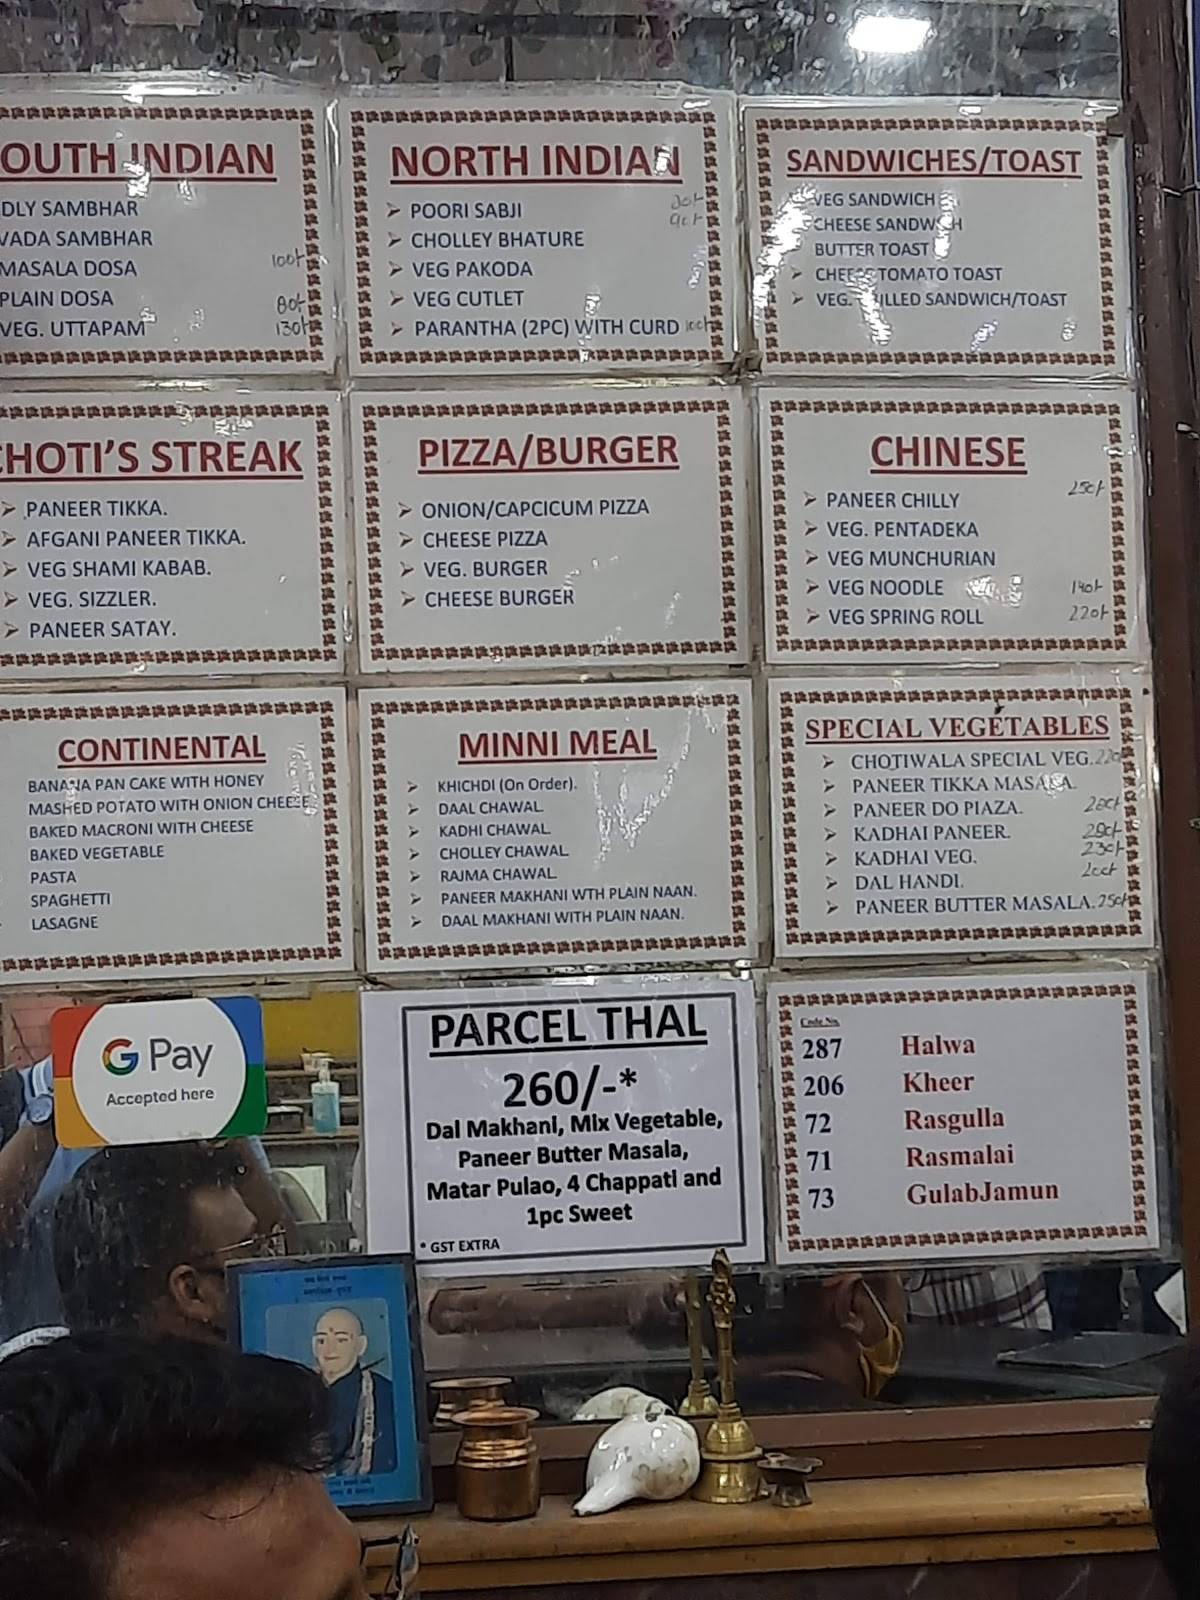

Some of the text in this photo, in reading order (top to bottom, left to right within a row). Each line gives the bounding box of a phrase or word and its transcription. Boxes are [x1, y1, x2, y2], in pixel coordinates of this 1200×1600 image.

[131, 143, 274, 174] INDIAN
[391, 146, 680, 177] NORTH INDIAN
[787, 147, 1081, 175] SANDWICHES/TOAST
[815, 192, 935, 207] VEG SANDWICH
[43, 201, 138, 217] SAMBHAR
[411, 202, 522, 219] POORI SABJI
[813, 218, 871, 232] CHEESE
[56, 231, 153, 247] SAMBHAR
[412, 231, 584, 249] CHOLLEY BHATURE
[815, 242, 928, 257] BUTTER TOAST
[0, 261, 137, 277] MASALA DOSA
[413, 261, 533, 278] VEG PAKODA
[879, 267, 1002, 281] TOMATO TOAST
[0, 291, 114, 307] PLAIN DOSA
[414, 291, 524, 307] VEG CUTLET
[926, 292, 1067, 308] SANDWICH/TOAST
[0, 321, 145, 338] VEG. UTTAPAM
[415, 319, 679, 339] PARANTHA (2PC) WITH CURD
[152, 440, 303, 473] STREAK
[419, 434, 679, 471] PIZZA/BURGER
[871, 436, 1026, 468] CHINESE
[26, 500, 168, 517] PANEER TIKKA.
[827, 492, 960, 508] PANEER CHILLY
[422, 499, 649, 520] ONION/CAPCICUM PIZZA
[828, 521, 979, 537] VEG. PENTADEKA
[27, 530, 246, 548] AFGANI PANEER TIKKA.
[424, 531, 547, 548] CHEESE PIZZA
[828, 551, 996, 566] VEG MUNCHURIAN
[28, 560, 211, 577] VEG SHAMI KABAB.
[424, 561, 547, 577] VEG. BURGER
[829, 580, 944, 595] VEG NOODLE
[29, 591, 156, 608] VEG. SIZZLER.
[425, 589, 574, 608] CHEESE BURGER
[829, 609, 984, 624] VEG SPRING ROLL
[30, 621, 177, 638] PANEER SATAY.
[807, 715, 1109, 739] SPECIAL VEGETABLES
[58, 735, 266, 763] CONTINENTAL
[459, 728, 657, 758] MINNI MEAL
[852, 752, 1046, 770] CHOTIWALA SPECIAL
[95, 774, 264, 791] PAN CAKE WITH HONEY
[438, 780, 495, 792] KHICHDI
[499, 778, 524, 793] (On
[853, 776, 989, 794] PANEER TIKKA
[28, 798, 253, 816] MASHED POTATO WITH ONION
[439, 803, 475, 815] DAAL
[854, 803, 926, 817] PANEER
[932, 802, 959, 816] DO
[29, 820, 254, 839] BAKED MACRONI WITH CHEESE
[440, 824, 483, 838] KADHI
[854, 826, 928, 841] KADHAI
[31, 845, 165, 861] BAKED VEGETABLE
[440, 847, 501, 861] CHOLLEY
[855, 851, 929, 865] KADHAI
[31, 871, 76, 885] PASTA
[856, 875, 894, 890] DAL
[31, 893, 110, 908] SPAGHETTI
[441, 892, 496, 905] PANEER
[500, 890, 568, 903] MAKHANI
[610, 887, 649, 900] PLAIN
[653, 885, 696, 899] NAAN.
[857, 897, 1007, 914] PANEER BUTTER
[32, 916, 98, 931] LASAGNE
[442, 908, 684, 928] DAAL MAKHANI WITH PLAIN NAAN.
[430, 1003, 707, 1049] PARCEL THAL
[803, 1035, 975, 1059] 287 Halwa
[102, 1038, 213, 1077] G Pay
[803, 1072, 975, 1096] 206 Kheer
[106, 1088, 214, 1107] Accepted here
[426, 1108, 723, 1140] Dal Makhani, Mix Vegetable,
[805, 1108, 1005, 1134] 72 Rasgulla
[459, 1140, 689, 1168] Paneer Butter Masala,
[807, 1144, 1015, 1171] 71 Rasmalai
[427, 1167, 721, 1200] Matar Pulao, 4 Chappati and
[809, 1182, 1059, 1208] 73 GulabJamun
[527, 1203, 632, 1228] 1pc Sweet
[430, 1238, 500, 1253] GST EXTRA
